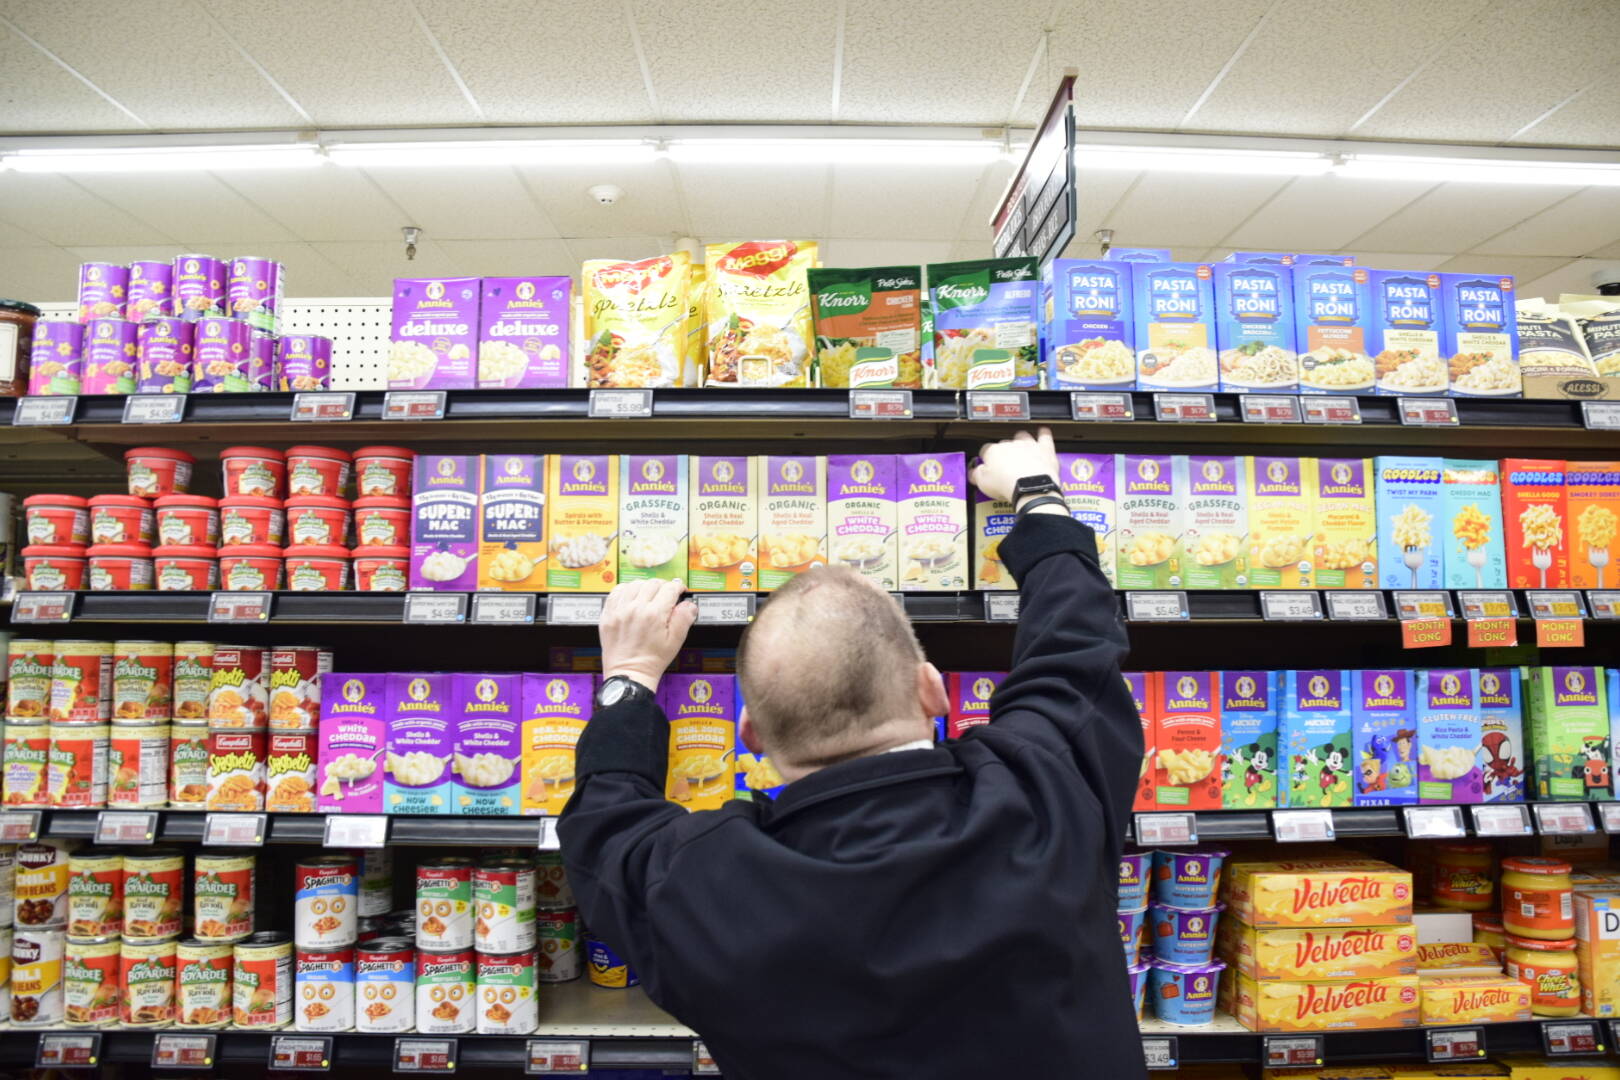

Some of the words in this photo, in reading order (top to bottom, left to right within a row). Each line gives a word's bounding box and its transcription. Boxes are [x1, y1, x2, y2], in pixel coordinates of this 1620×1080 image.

[1072, 276, 1114, 288] PASTA
[1154, 280, 1196, 292] PASTA
[1234, 279, 1274, 291] PASTA
[938, 284, 987, 298] Knorr
[1312, 283, 1353, 295] PASTA
[1388, 287, 1427, 298] PASTA
[818, 292, 870, 307] Knorr
[1075, 296, 1114, 308] RONI
[1462, 290, 1500, 302] PASTA
[1156, 298, 1196, 312] RONI
[1236, 298, 1276, 312] RONI
[1315, 302, 1354, 315] RONI
[1391, 306, 1428, 319] RONI
[1464, 310, 1500, 322] RONI
[400, 320, 468, 336] deluxe
[489, 320, 559, 336] deluxe
[852, 365, 896, 381] Knorr
[971, 365, 1014, 381] Knorr
[1510, 472, 1564, 486] GOODLES
[562, 481, 606, 493] Annie's
[632, 480, 676, 493] Annie's
[702, 482, 745, 494] Annie's
[771, 482, 814, 494] Annie's
[840, 483, 886, 494] Annie's
[908, 482, 955, 494] Annie's
[1128, 480, 1170, 492] Annie's
[1194, 481, 1235, 492] Annie's
[1258, 482, 1298, 494] Annie's
[1322, 484, 1362, 495] Annie's
[626, 500, 681, 512] GRASSFED
[700, 500, 747, 512] ORGANIC
[768, 500, 816, 512] ORGANIC
[1123, 499, 1176, 511] GRASSFED
[1188, 499, 1241, 511] GRASSFED
[419, 504, 471, 520] SUPER!
[486, 504, 539, 519] SUPER!
[429, 520, 459, 530] MAC
[496, 520, 527, 530] MAC
[722, 610, 746, 620] $5.49
[1408, 621, 1445, 631] MONTH
[1474, 620, 1510, 630] MONTH
[1542, 622, 1576, 631] MONTH
[1413, 633, 1441, 642] LONG
[1480, 632, 1506, 642] LONG
[1546, 633, 1574, 642] LONG
[1168, 698, 1208, 710] Annie's
[1226, 698, 1266, 709] Annie's
[1300, 697, 1340, 708] Annie's
[1365, 697, 1404, 708] Annie's
[1431, 696, 1470, 706] Annie's
[1480, 695, 1510, 705] nnie's
[1558, 693, 1596, 704] Annie's
[331, 703, 376, 714] Annie's
[398, 702, 440, 712] Annie's
[464, 702, 510, 712] Annie's
[534, 704, 581, 714] Annie's
[678, 703, 724, 714] Annie's
[1178, 874, 1206, 884] Annie's
[30, 884, 56, 896] BEANS
[1293, 876, 1382, 914] Velveeta
[1295, 928, 1385, 968] Velveeta
[1417, 944, 1470, 962] Velveeta
[1539, 983, 1567, 992] Whiz
[1296, 981, 1390, 1020] Velveeta
[1453, 988, 1510, 1014] Velveeta
